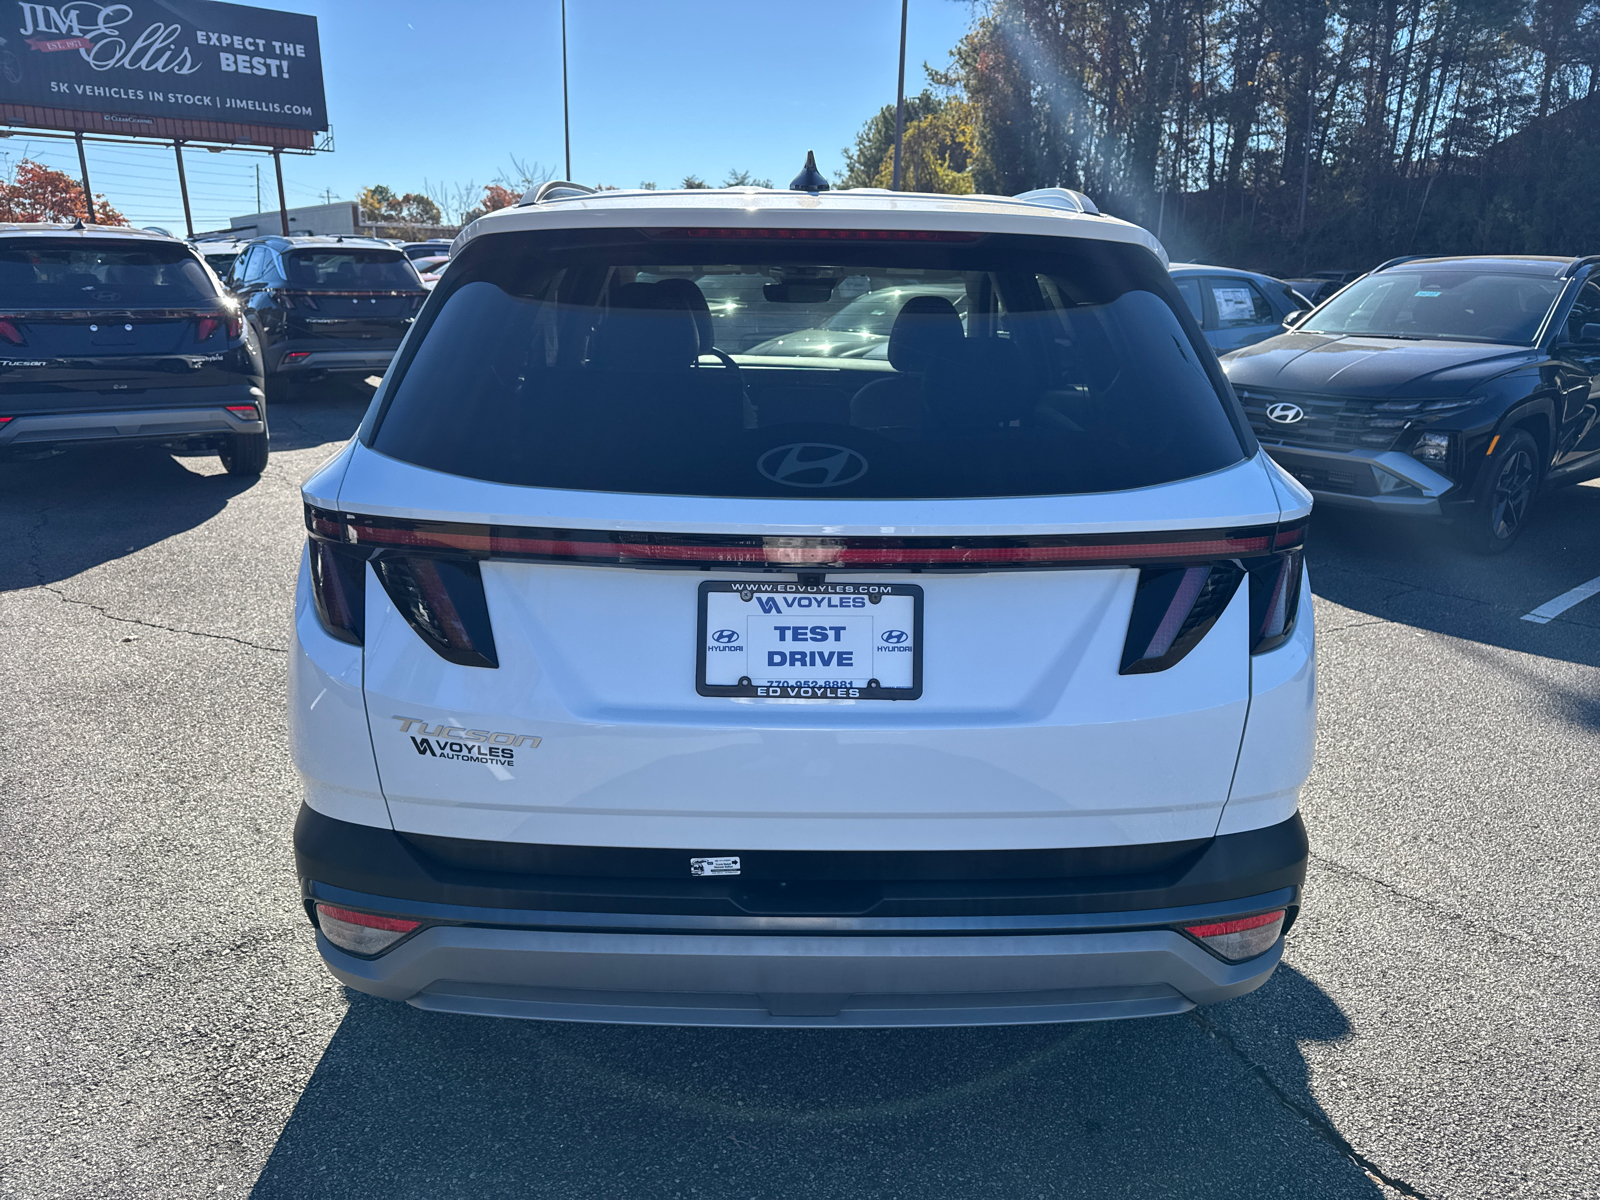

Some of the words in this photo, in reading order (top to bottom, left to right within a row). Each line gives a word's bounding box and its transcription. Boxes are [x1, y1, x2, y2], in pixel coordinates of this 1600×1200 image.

[19, 2, 83, 36] JIM
[61, 1, 202, 74] Ellis
[46, 42, 65, 50] EST.
[66, 40, 82, 48] 1971
[196, 30, 265, 52] EXPECT
[272, 41, 306, 57] THE
[219, 52, 290, 78] BEST!
[50, 81, 70, 93] 5K
[74, 84, 144, 100] VEHICLES
[149, 91, 164, 101] IN
[168, 93, 212, 106] STOCK
[225, 98, 312, 116] JIMELLIS.COM
[731, 583, 892, 593] WWW.EDVOYLES.COM
[783, 596, 866, 608] VOYLES
[773, 625, 847, 642] TEST
[767, 651, 854, 667] DRIVE
[757, 687, 781, 696] ED
[787, 688, 860, 697] VOYLES
[391, 714, 543, 749] Tucson
[436, 740, 514, 759] VOYLES
[439, 752, 515, 766] AUTOMOTIVE
